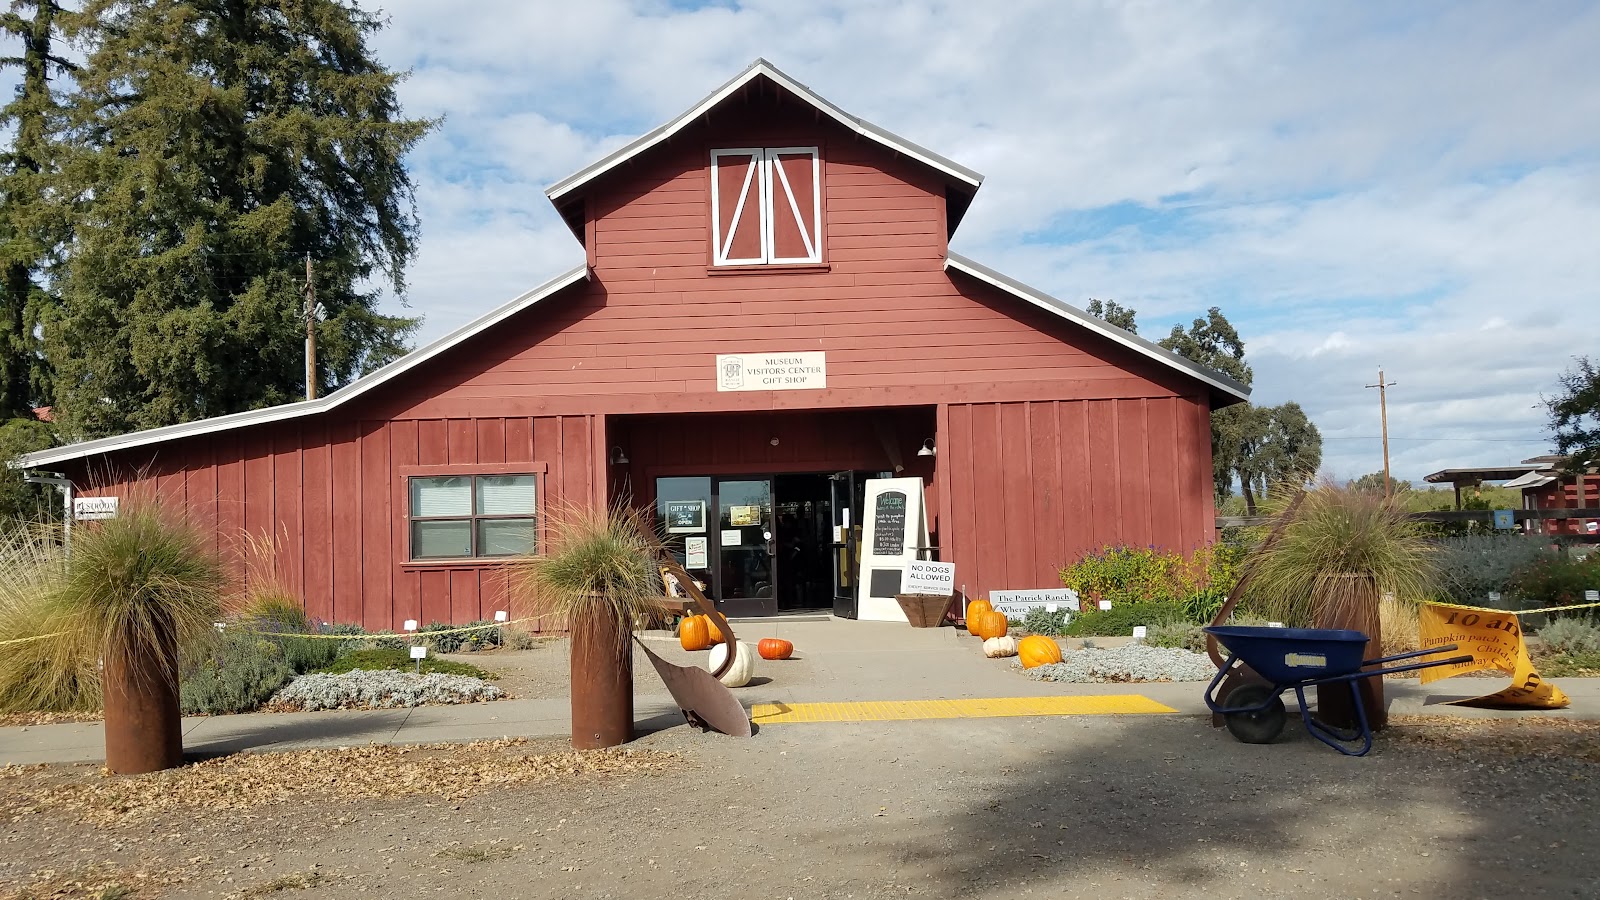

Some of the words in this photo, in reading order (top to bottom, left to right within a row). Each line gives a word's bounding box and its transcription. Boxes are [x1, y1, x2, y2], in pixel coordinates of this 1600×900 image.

[765, 358, 803, 366] MUSEUM
[762, 377, 782, 385] GIFT
[925, 565, 950, 574] DOGS
[910, 573, 951, 582] ALLOWED
[998, 594, 1013, 602] The
[1015, 594, 1042, 602] Patrick
[1045, 593, 1070, 601] Ranch
[1000, 605, 1027, 613] Where
[1444, 611, 1480, 627] 10
[1423, 632, 1466, 648] Pumpkin
[1468, 633, 1500, 644] patch
